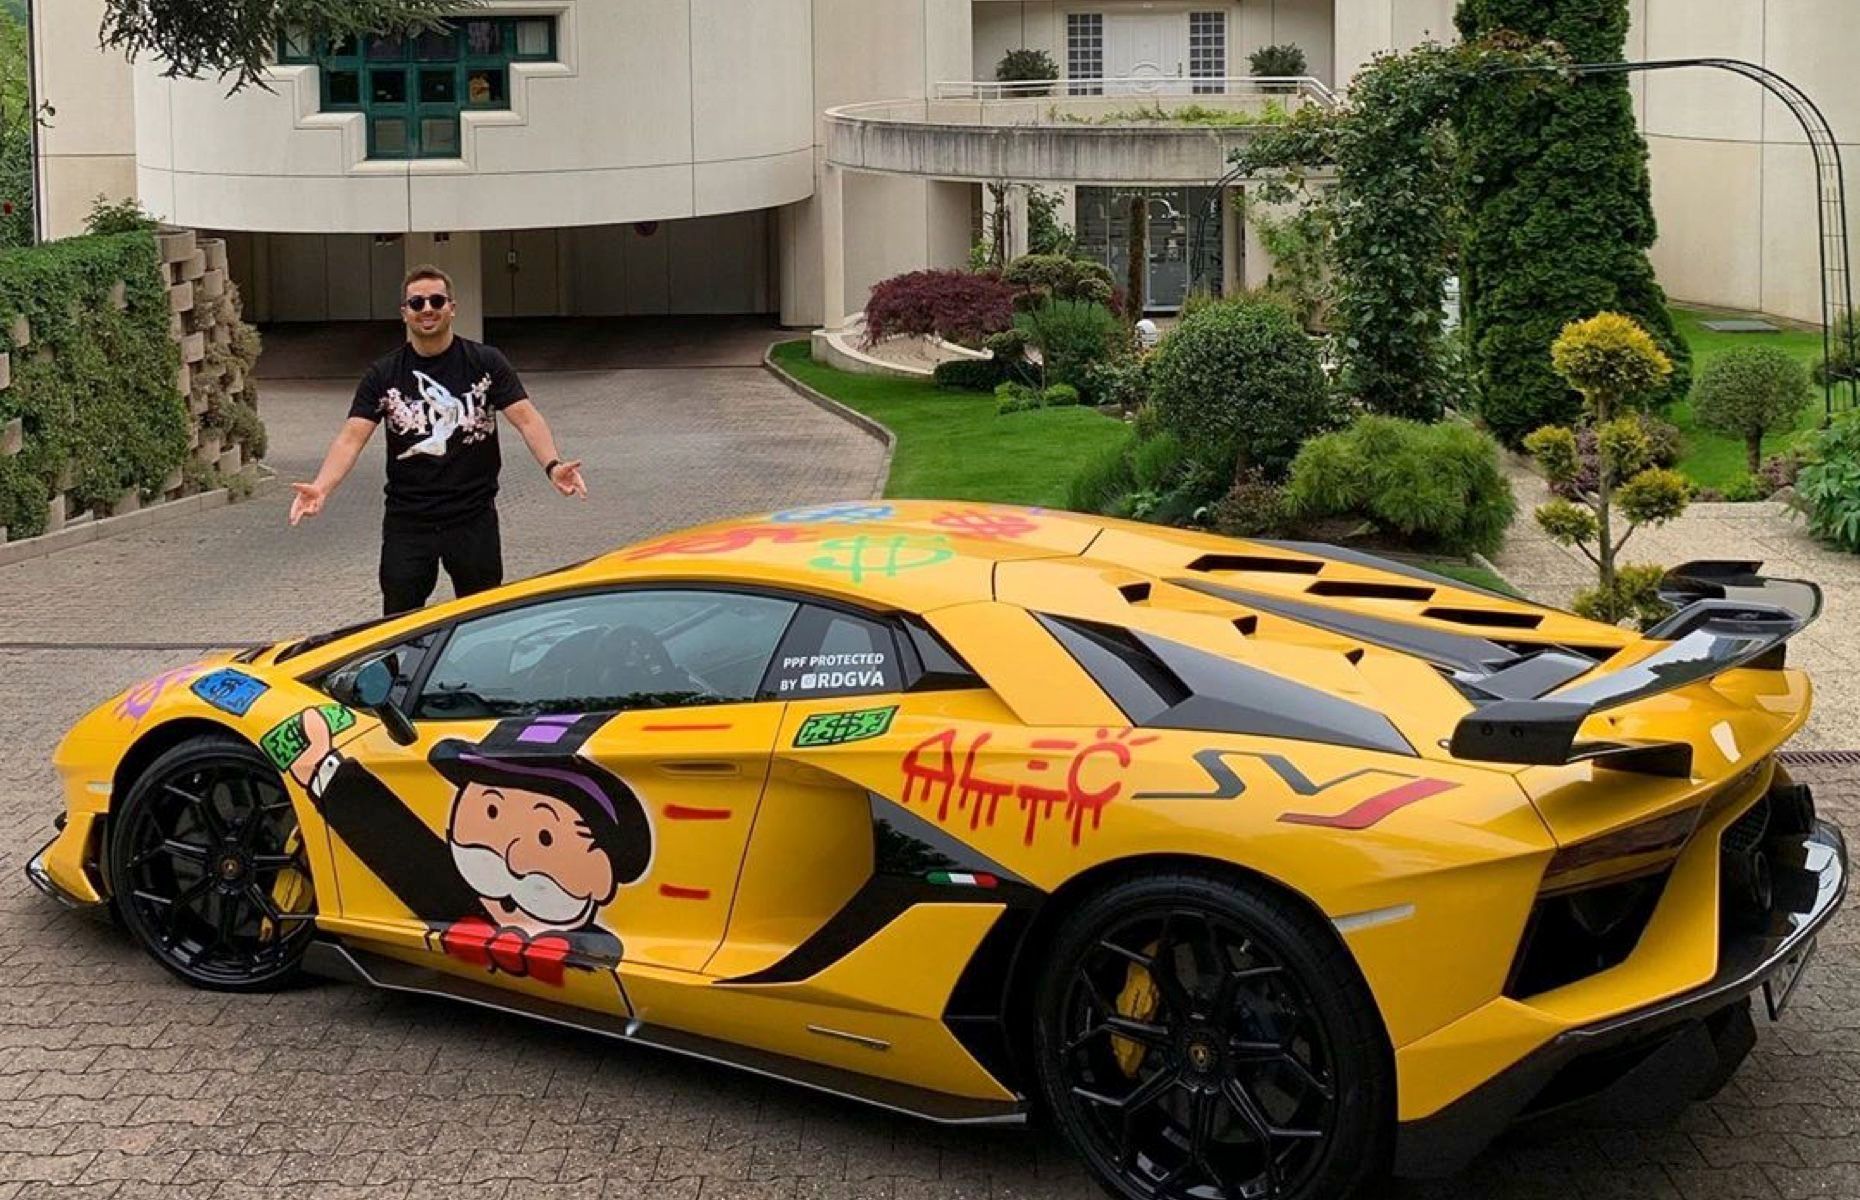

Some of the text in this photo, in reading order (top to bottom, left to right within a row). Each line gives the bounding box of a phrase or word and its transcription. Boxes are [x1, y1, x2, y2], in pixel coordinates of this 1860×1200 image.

[783, 652, 884, 669] PPF PROTECTED
[781, 671, 885, 691] BY RDGVA
[902, 729, 1131, 846] ALEC
